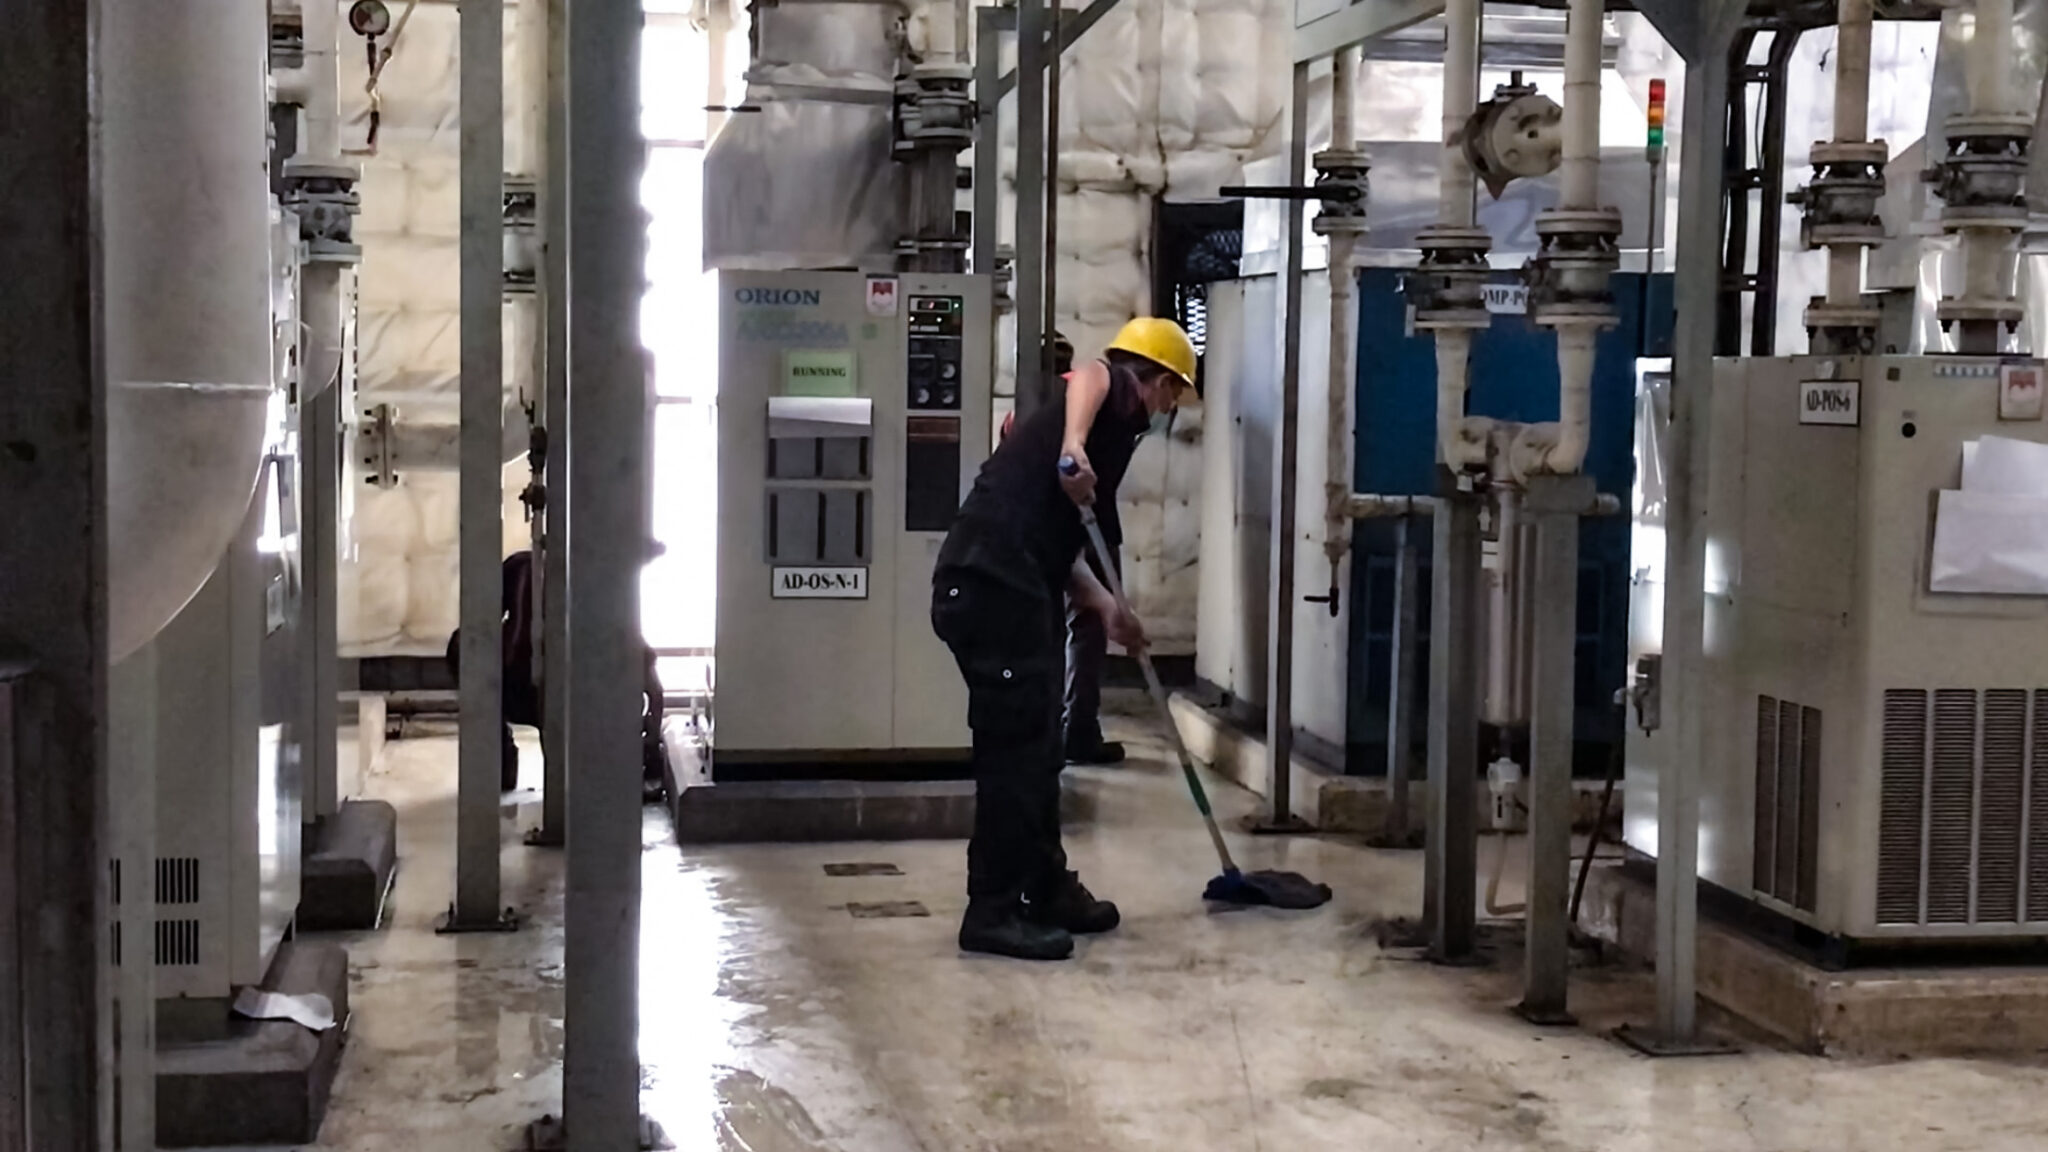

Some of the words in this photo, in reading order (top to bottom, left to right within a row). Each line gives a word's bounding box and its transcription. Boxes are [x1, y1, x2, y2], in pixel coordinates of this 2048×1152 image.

[734, 288, 820, 305] ORION
[792, 367, 846, 377] RUNNING
[782, 573, 858, 589] AD-OS-N-1
